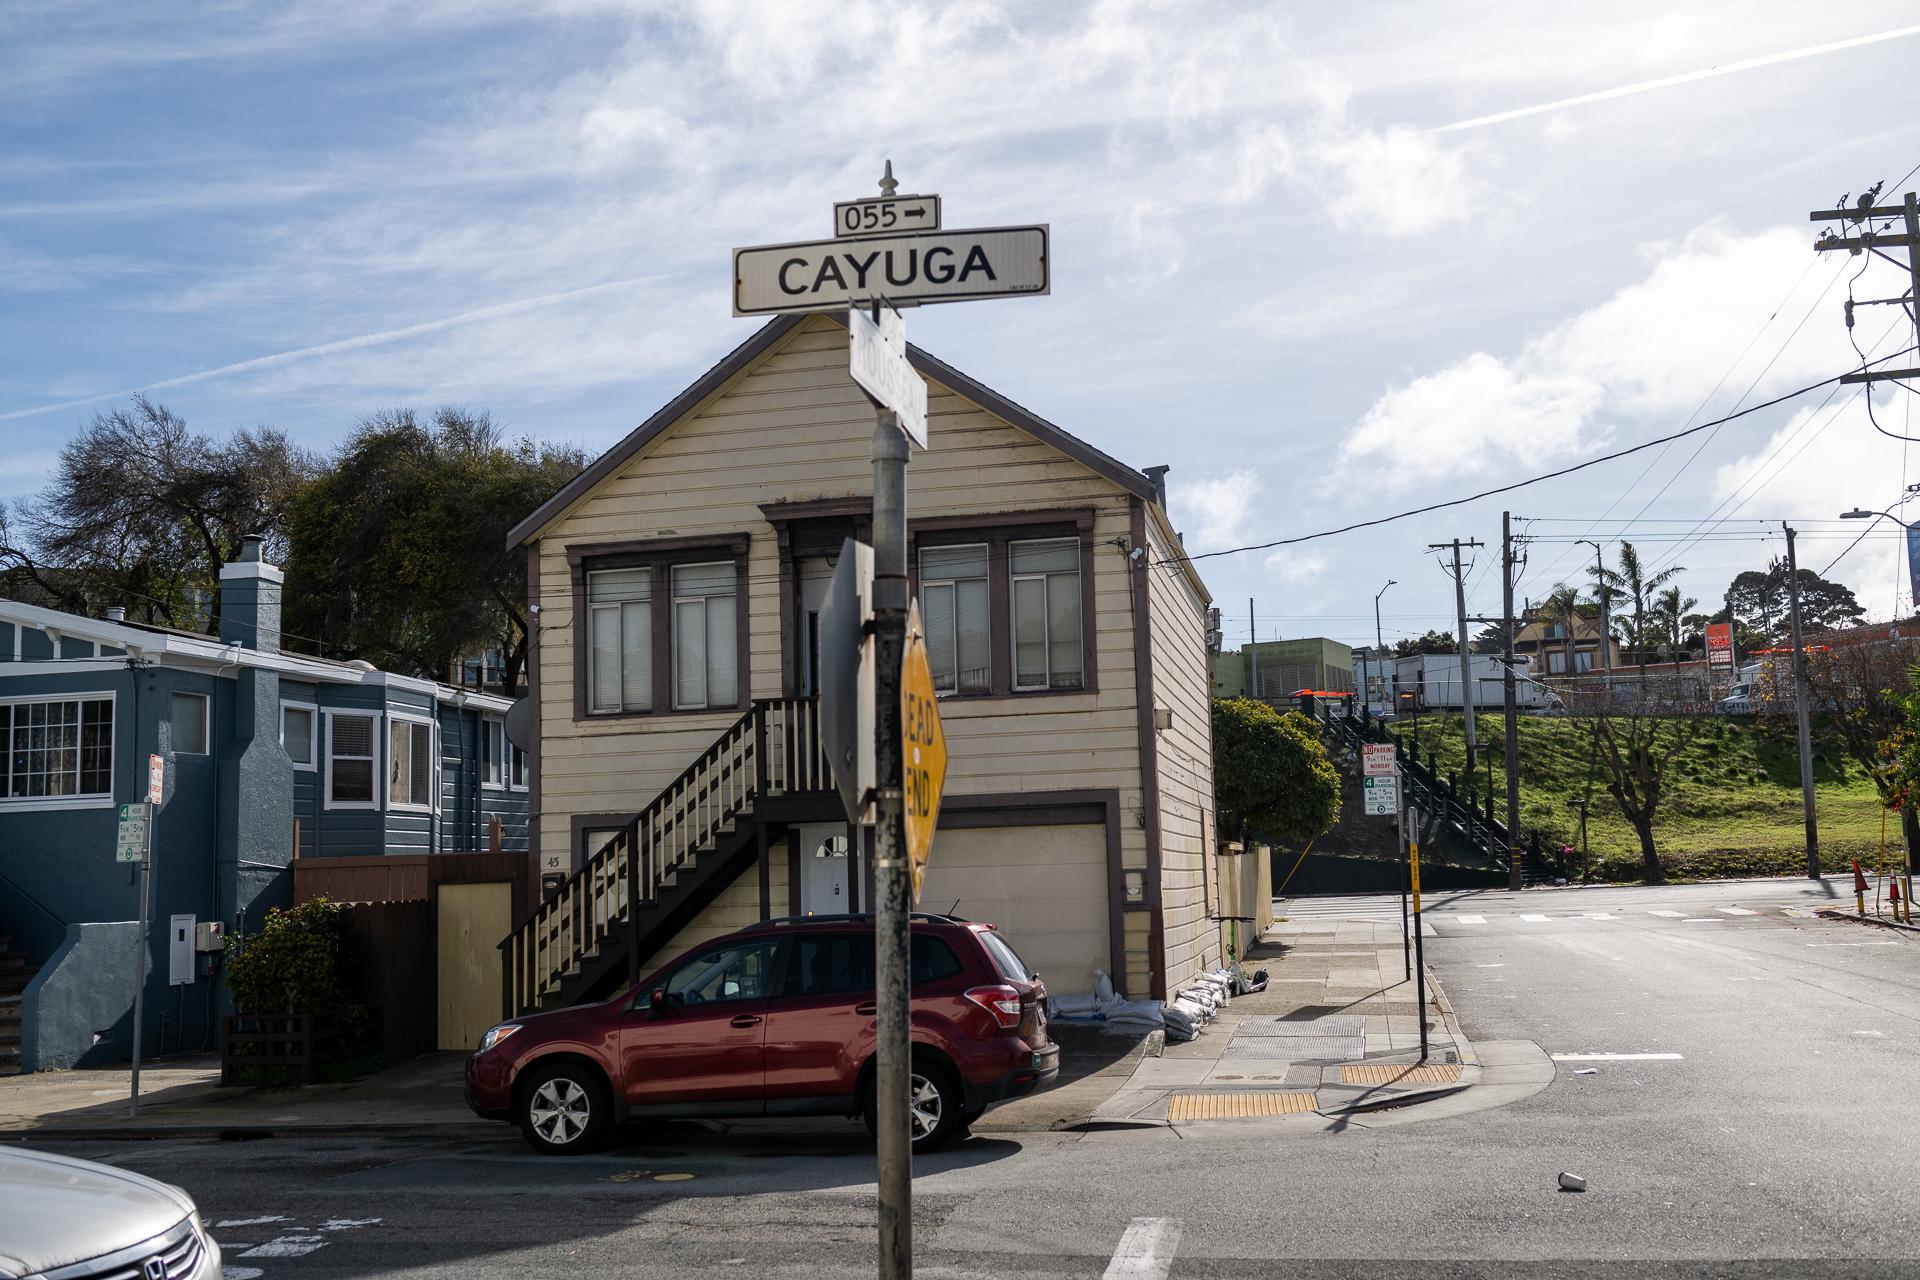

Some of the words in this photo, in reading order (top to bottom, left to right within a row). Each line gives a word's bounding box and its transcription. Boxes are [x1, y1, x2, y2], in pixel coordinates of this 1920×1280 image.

[844, 203, 898, 231] 055
[778, 244, 998, 296] CAYUGA
[857, 324, 921, 427] ROUSSEAU
[1363, 745, 1373, 754] NO
[1374, 746, 1394, 754] PARKING
[906, 767, 931, 818] END
[1365, 778, 1373, 787] 4
[120, 807, 128, 820] 4
[132, 807, 142, 815] HOUR
[119, 824, 130, 833] 9AM
[133, 823, 144, 833] 5PM
